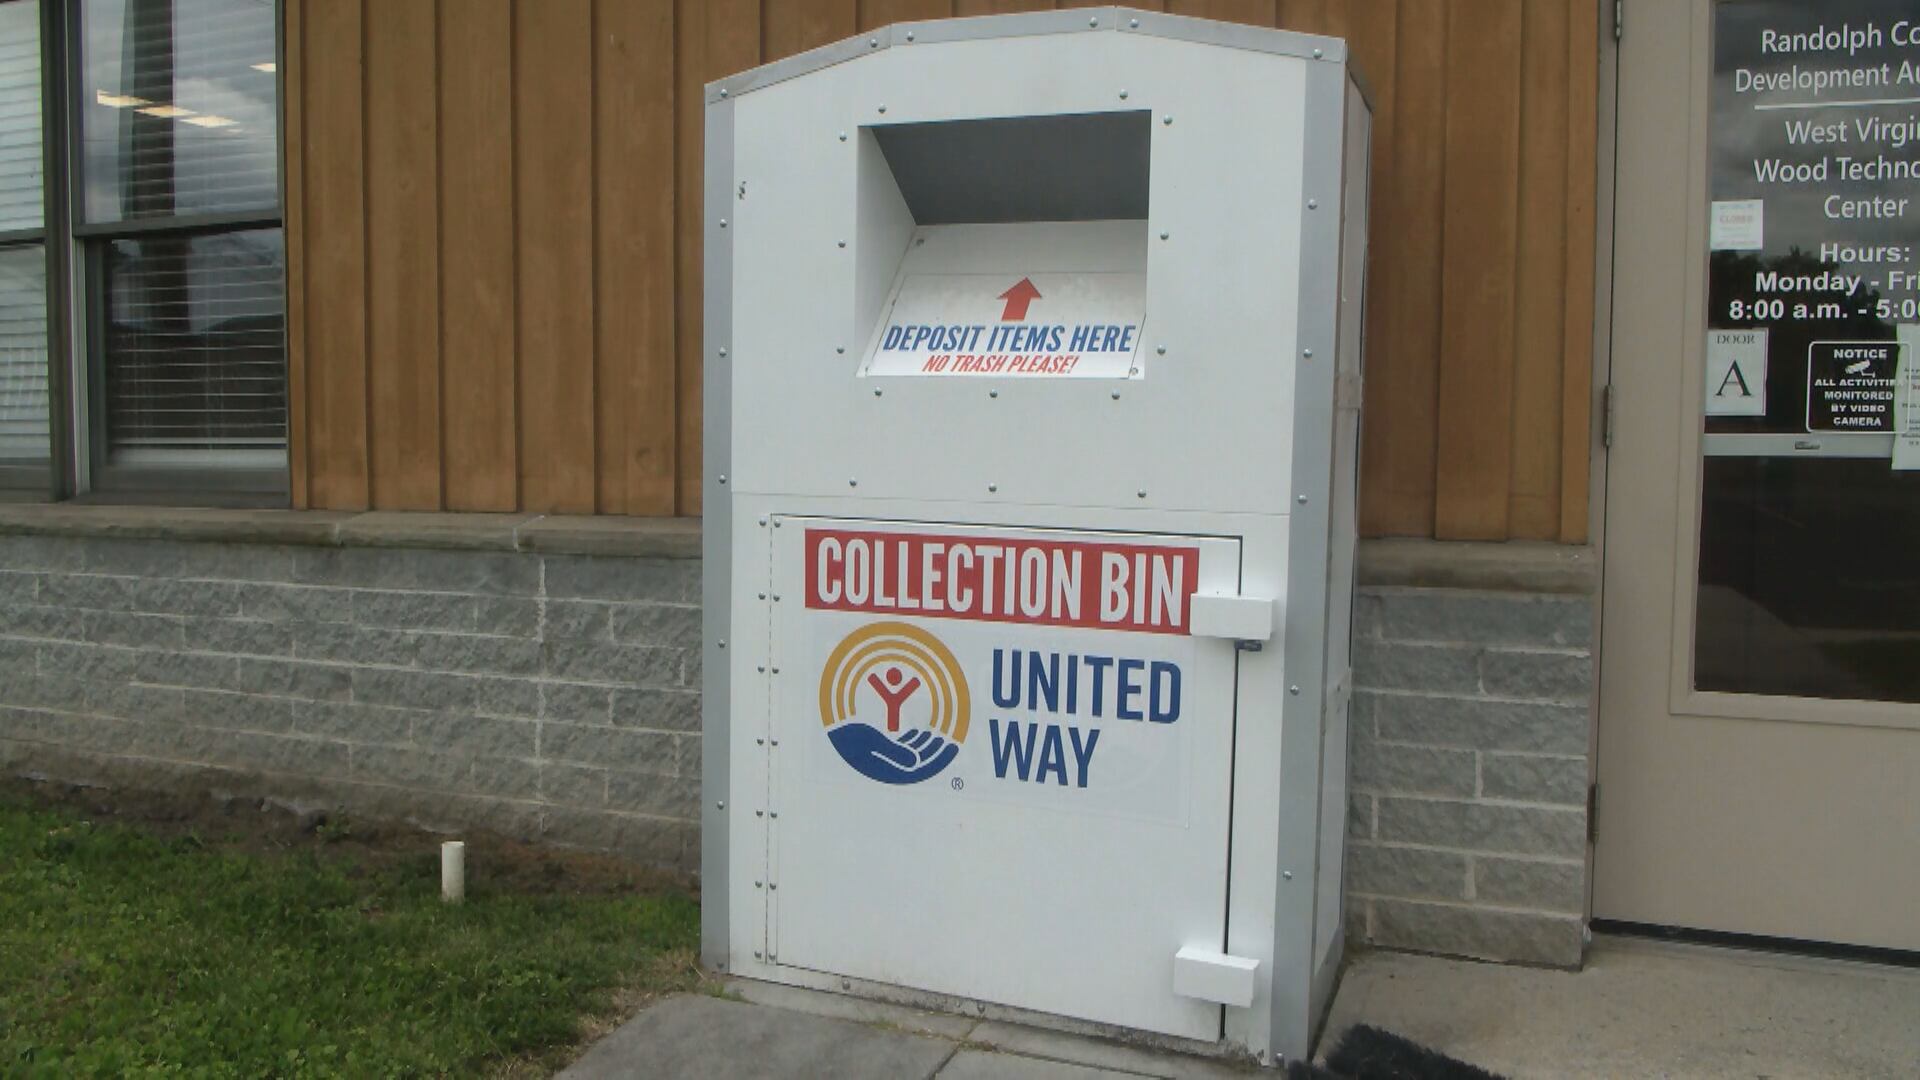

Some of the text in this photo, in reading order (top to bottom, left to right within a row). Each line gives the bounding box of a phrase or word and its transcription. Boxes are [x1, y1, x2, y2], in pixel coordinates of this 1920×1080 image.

[1762, 23, 1882, 56] Randolph
[1735, 63, 1890, 95] Development
[1785, 115, 1920, 149] West Virgi
[1753, 157, 1828, 183] Wood
[1824, 195, 1909, 219] Center
[1820, 242, 1910, 263] Hours:
[1755, 271, 1861, 296] Monday
[1729, 299, 1785, 320] 8:00
[1792, 303, 1848, 319] a.m.
[1875, 299, 1920, 319] 5:0
[882, 324, 1136, 353] DEPOSIT ITEMS HERE
[1716, 334, 1756, 345] DOOR
[922, 354, 1080, 374] NO TRASH PLEASE!
[1833, 348, 1888, 359] NOTICE
[1715, 359, 1752, 397] A
[1814, 378, 1836, 387] ALL
[1824, 390, 1893, 401] MONITORED
[1831, 403, 1886, 413] BY VIDEO
[1833, 416, 1882, 426] CAMERA
[816, 537, 1184, 627] COLLECTION BIN
[991, 648, 1182, 724] UNITED
[988, 718, 1101, 788] WAY
